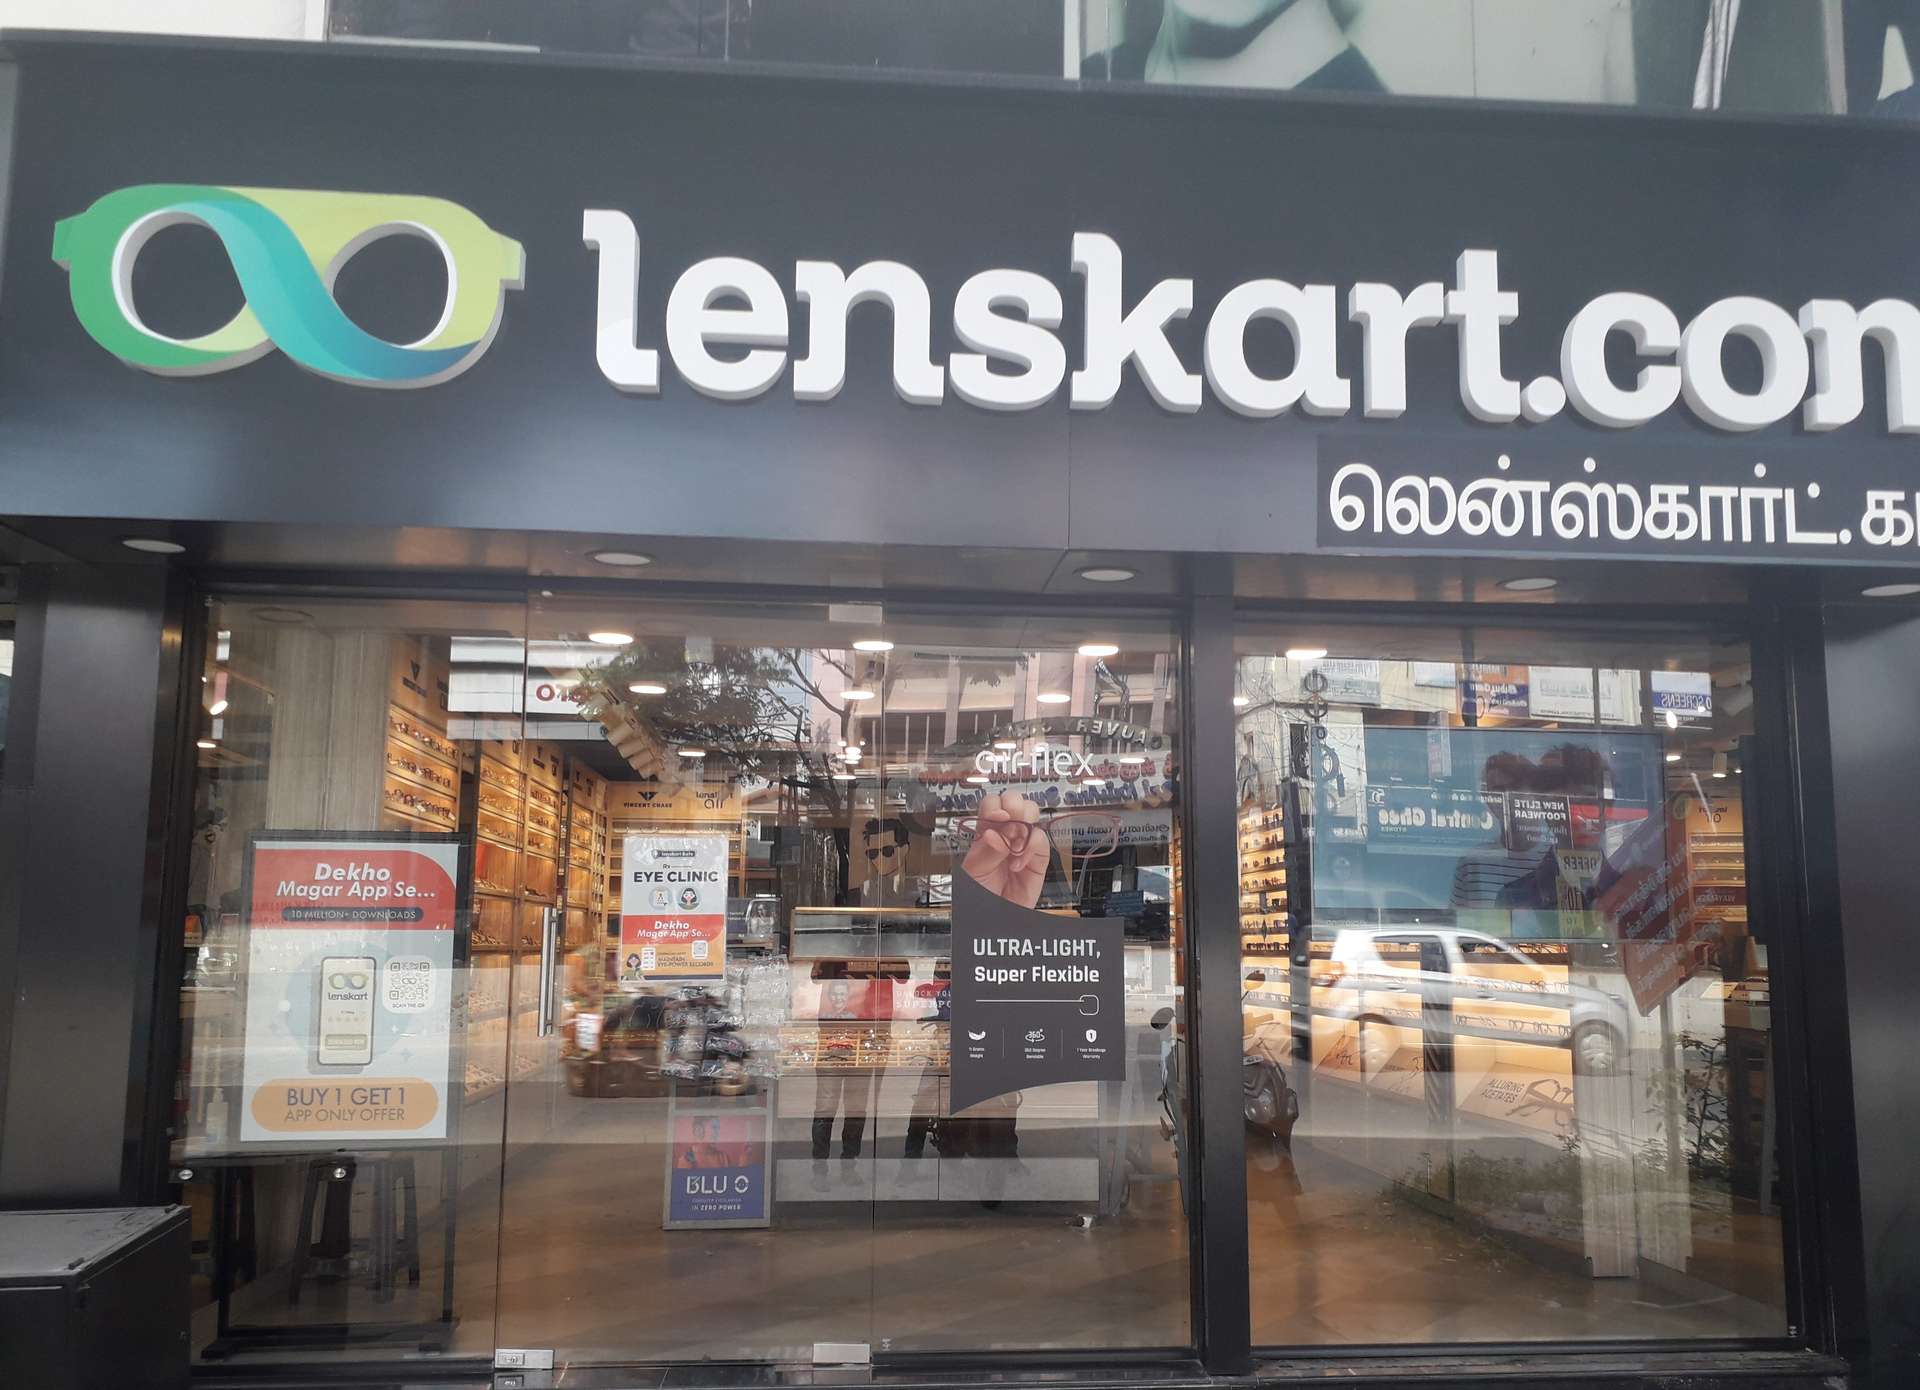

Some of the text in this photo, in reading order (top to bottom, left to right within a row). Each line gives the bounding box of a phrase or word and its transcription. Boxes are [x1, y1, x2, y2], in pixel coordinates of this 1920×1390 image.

[314, 863, 391, 881] Dekho
[633, 871, 719, 883] EYE CLINIC
[276, 881, 436, 901] Magar App Se...
[291, 910, 416, 919] 10 MILLION+ DOWNLOADS
[654, 920, 690, 930] Dekho
[637, 929, 669, 939] Magar
[670, 929, 689, 939] App
[973, 938, 1101, 959] ULTRA-LIGHT,
[974, 965, 1100, 985] Super Flexible
[328, 992, 368, 1001] lenskart
[287, 1087, 405, 1106] BUY 1 GET 1
[284, 1108, 405, 1122] APP ONLY OFFER
